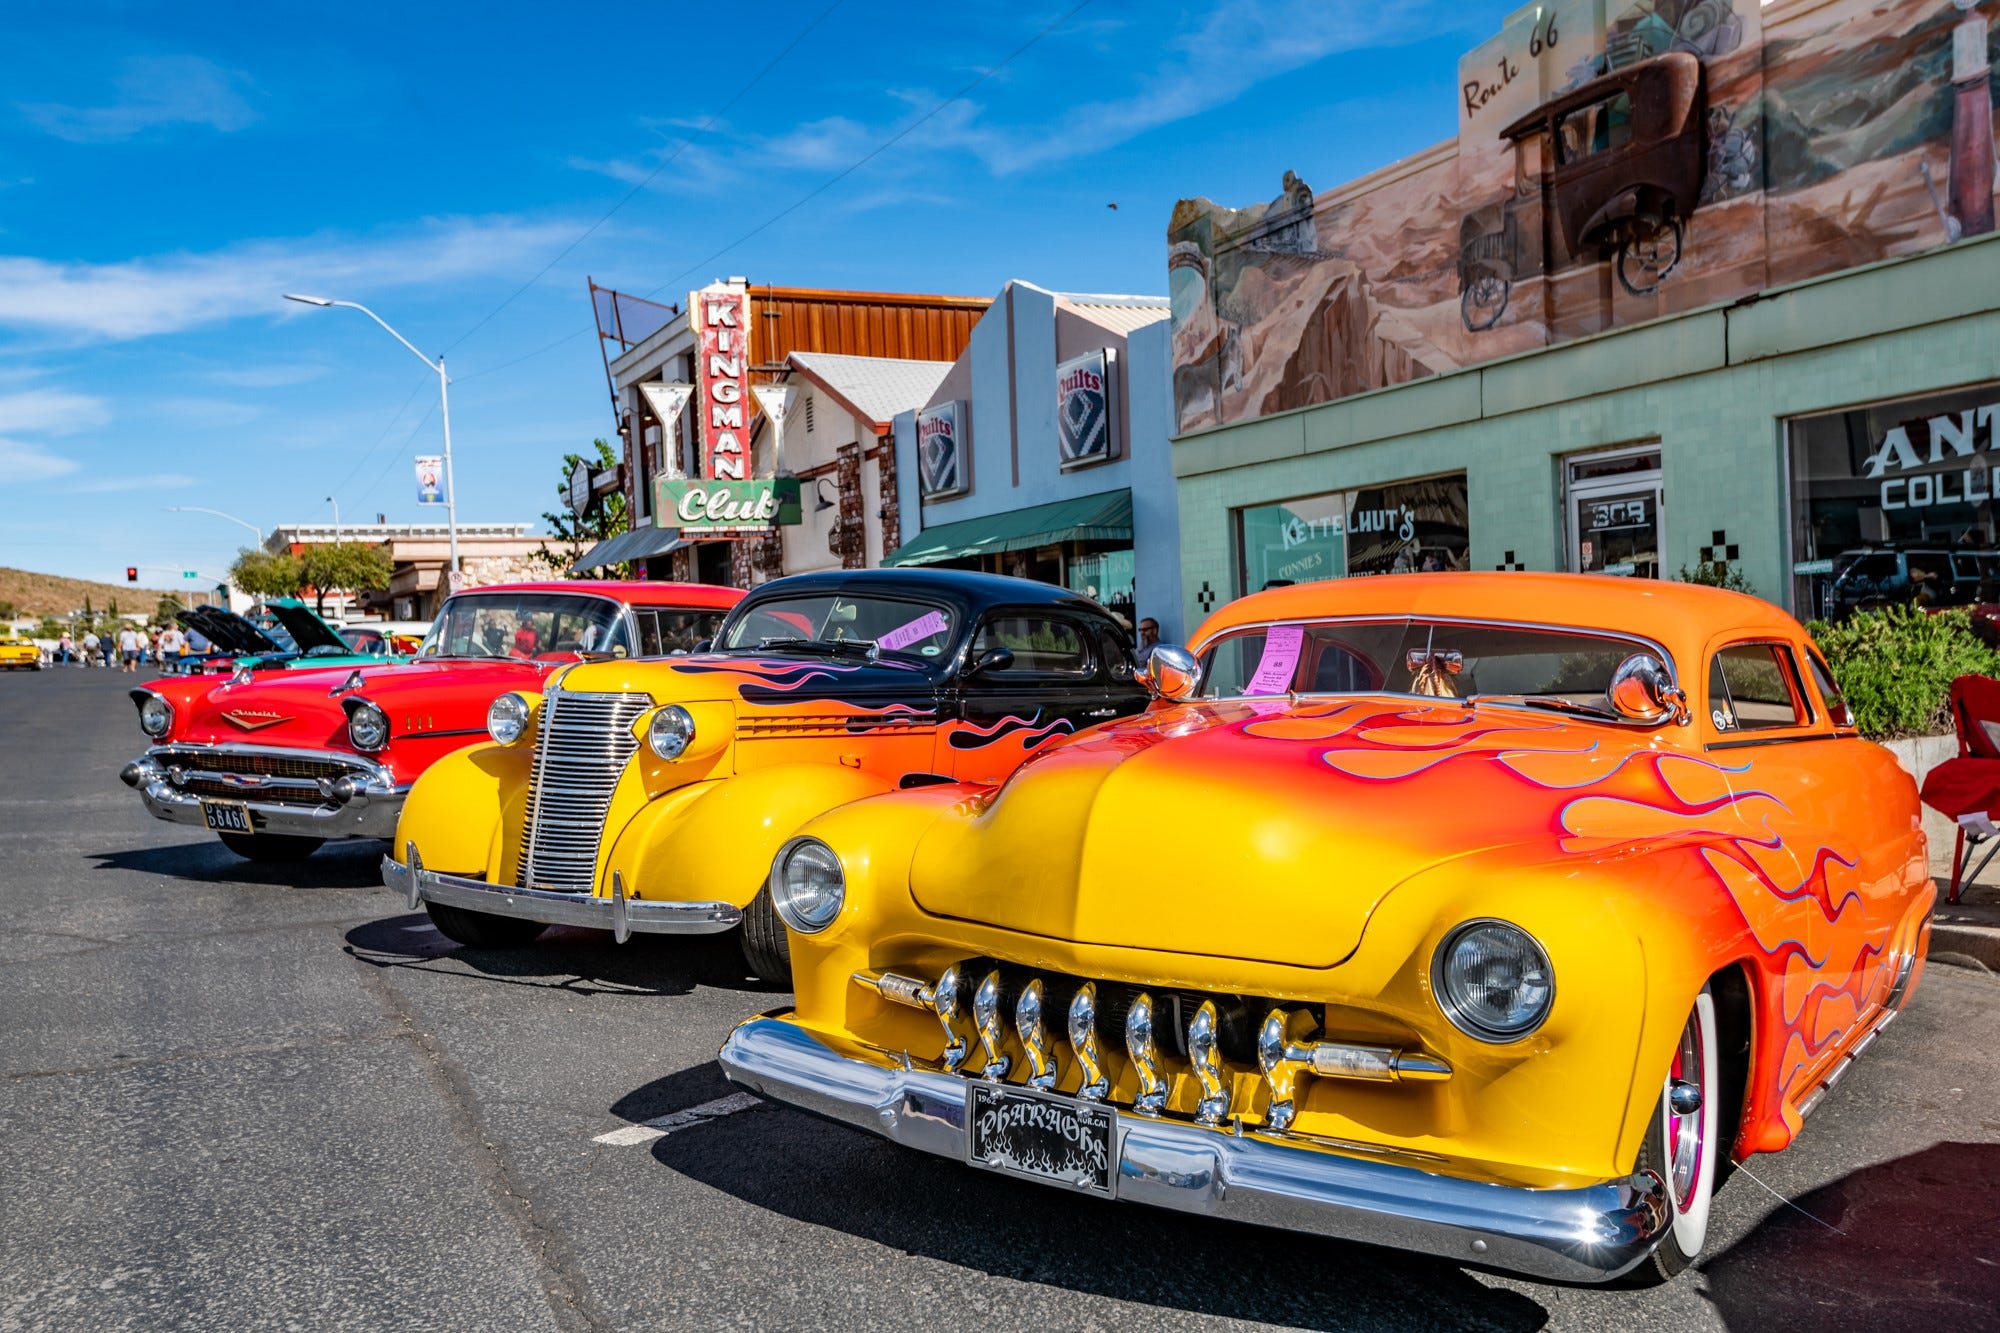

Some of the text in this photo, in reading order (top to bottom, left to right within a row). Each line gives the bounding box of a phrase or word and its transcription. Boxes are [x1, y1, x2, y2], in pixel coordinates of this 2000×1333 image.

[1463, 12, 1558, 119] Route 66
[707, 301, 744, 481] KINGMAN
[1059, 368, 1101, 404] Quilts
[921, 416, 951, 446] Quilts
[678, 487, 783, 521] Club
[1281, 504, 1415, 550] KETTELHUT'S
[977, 1094, 997, 1105] 1962
